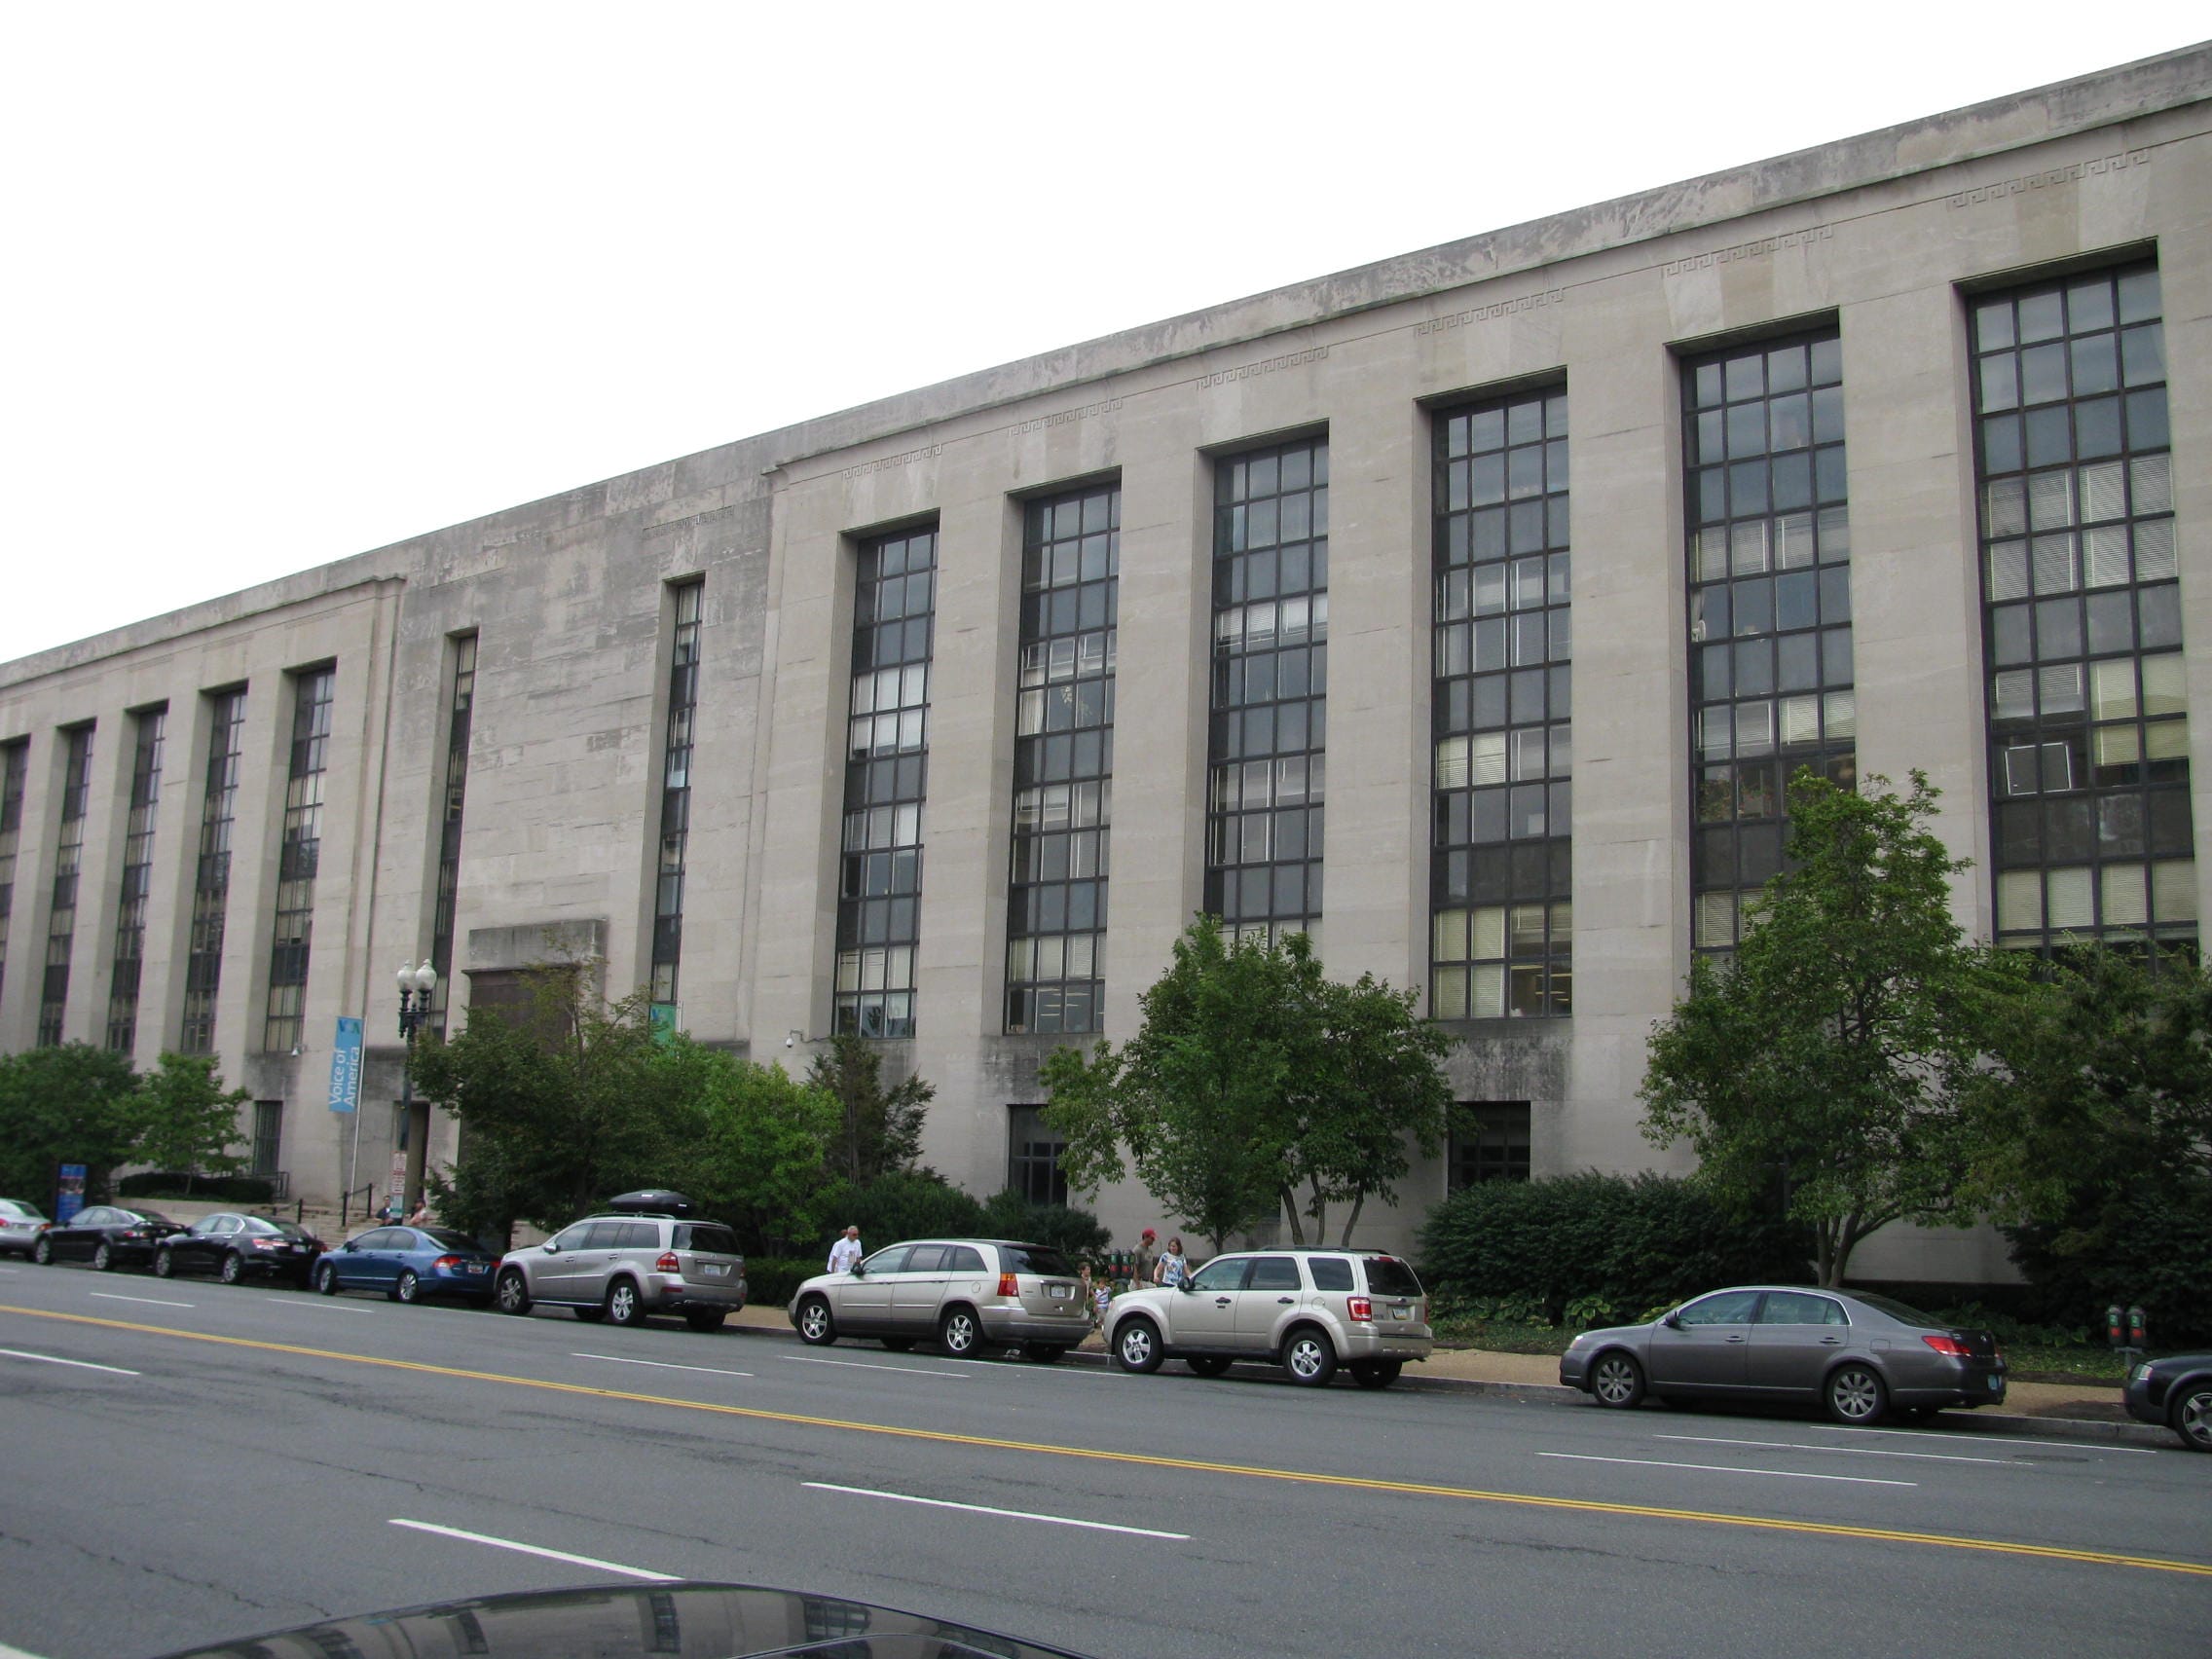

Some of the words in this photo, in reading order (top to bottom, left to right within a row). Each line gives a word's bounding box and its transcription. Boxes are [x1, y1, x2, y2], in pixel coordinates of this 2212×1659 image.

[335, 1050, 347, 1064] of
[329, 1066, 345, 1105] Voice
[344, 1047, 360, 1107] America
